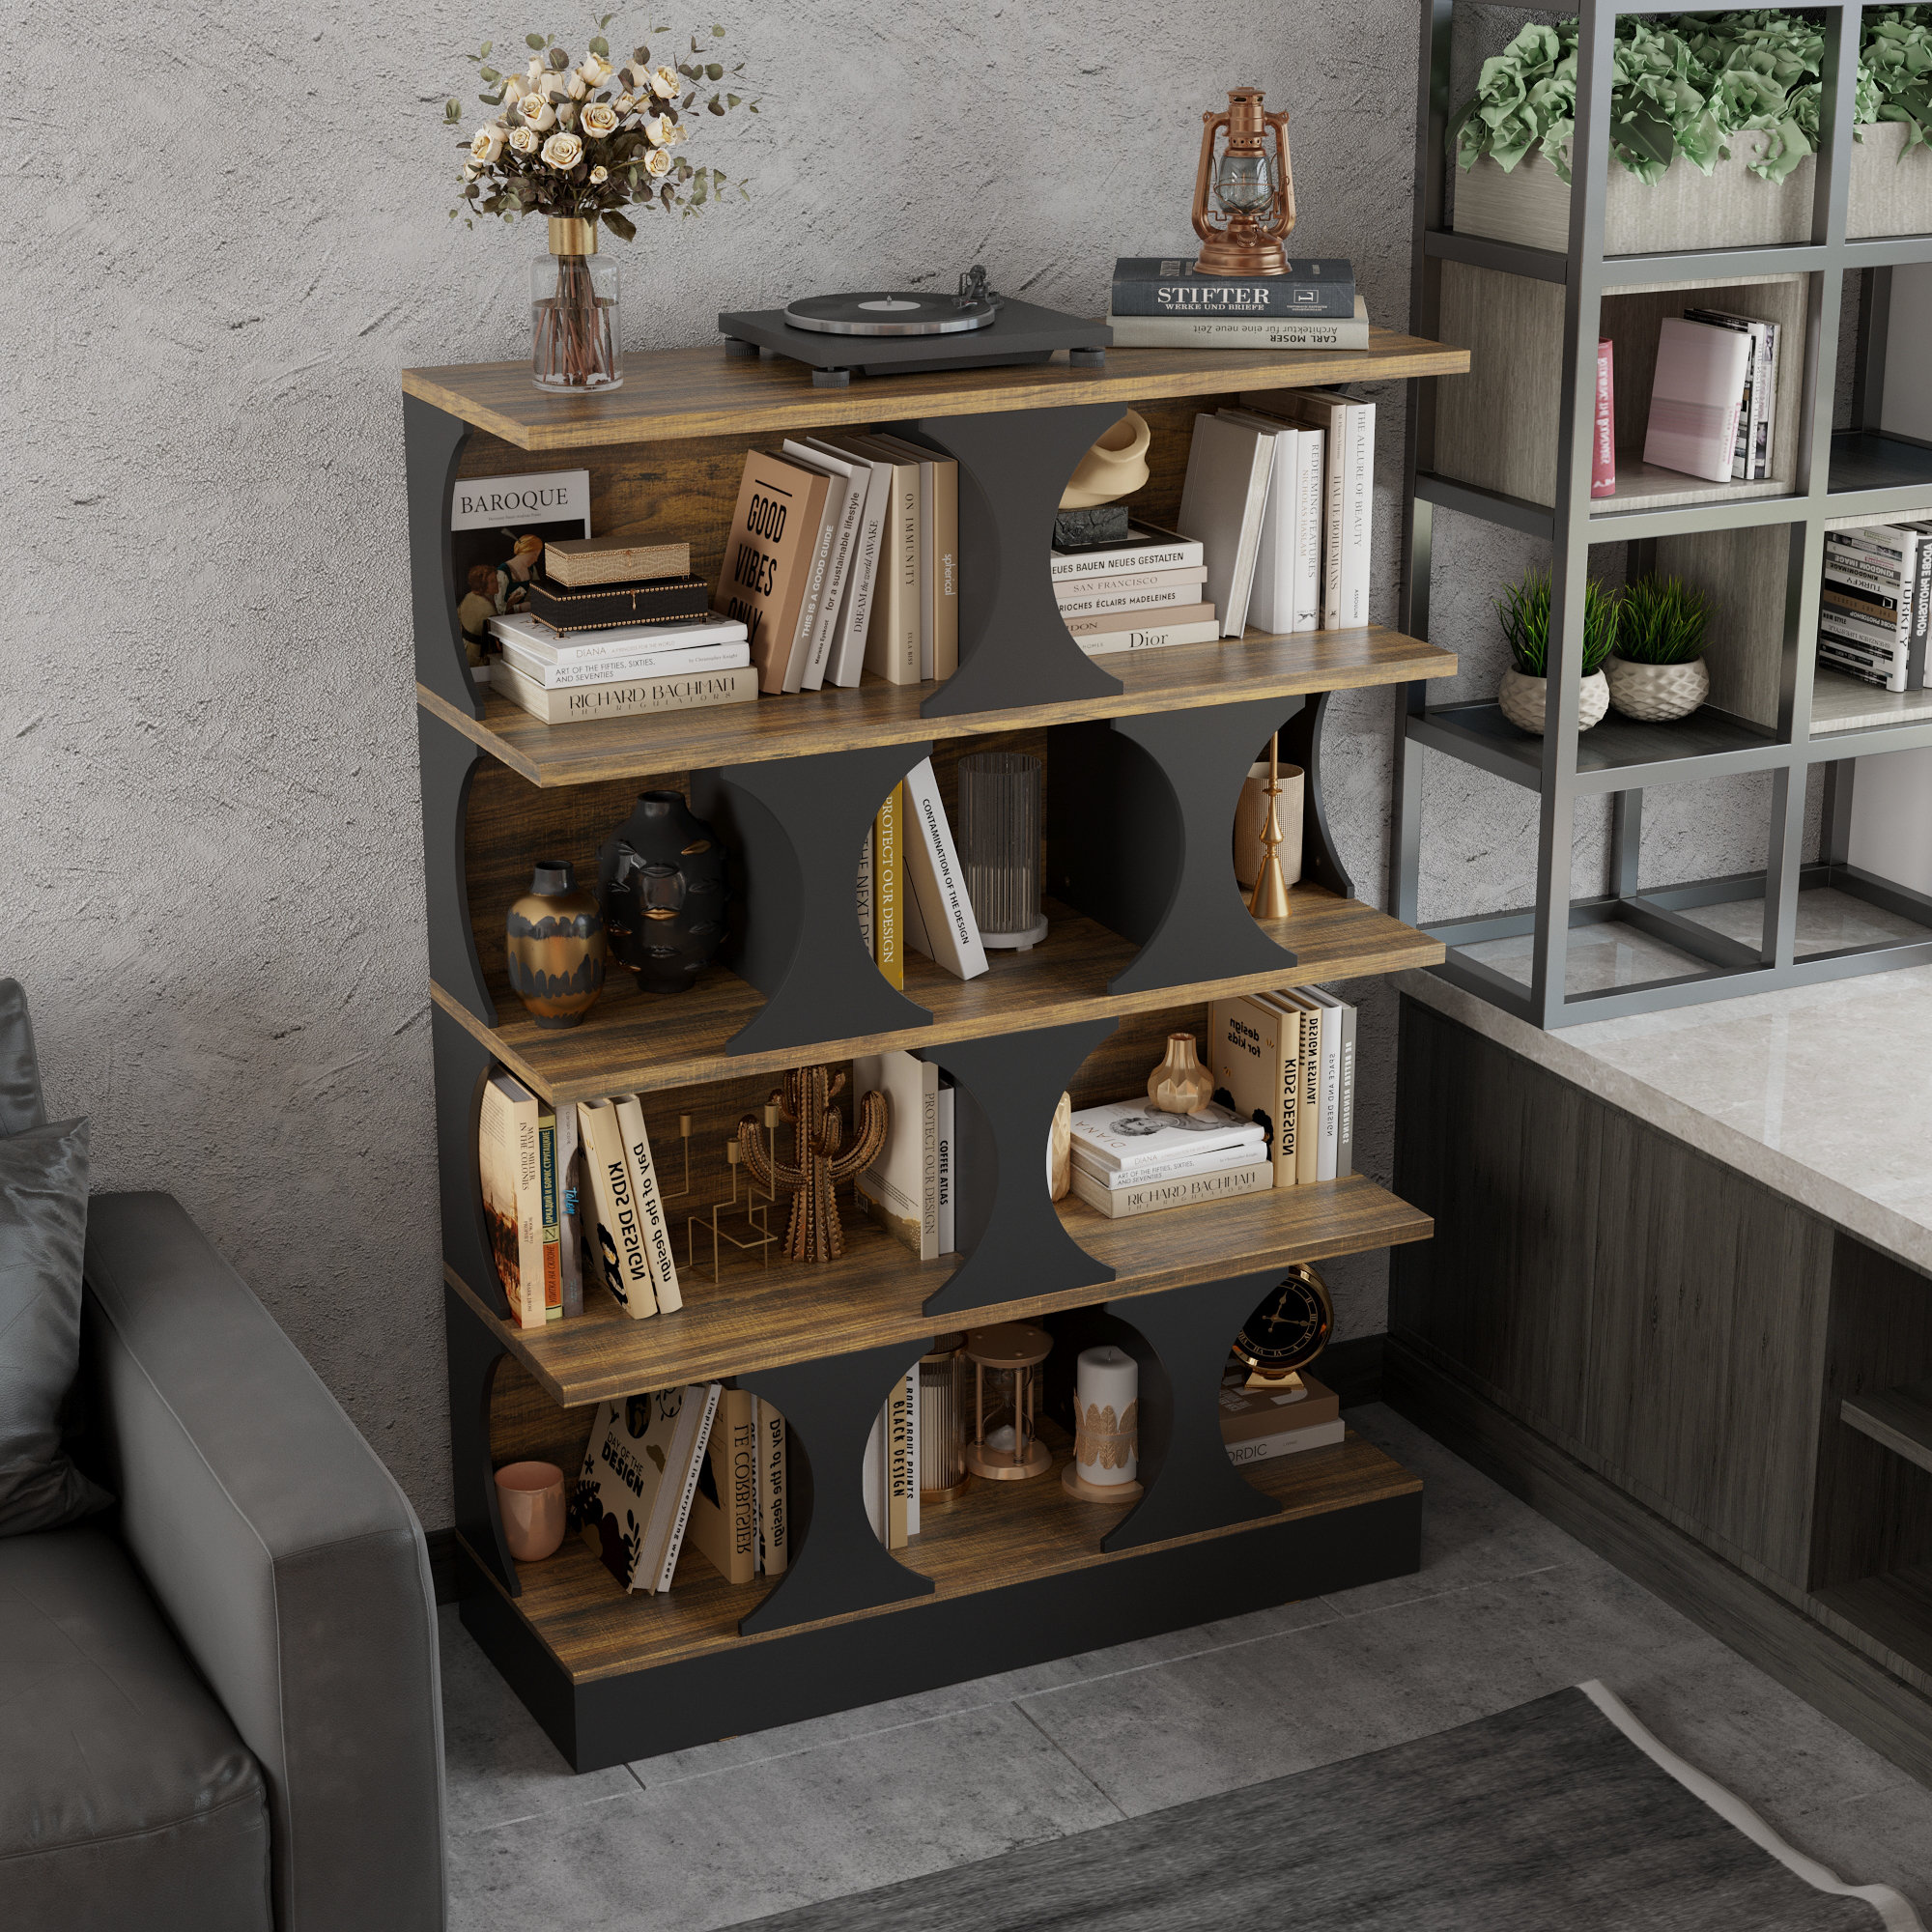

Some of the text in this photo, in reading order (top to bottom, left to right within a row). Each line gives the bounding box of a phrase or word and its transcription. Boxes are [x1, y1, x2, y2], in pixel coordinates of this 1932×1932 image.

[1157, 288, 1270, 304] STIFTER
[1266, 326, 1280, 334] für
[1357, 410, 1366, 433] THE
[1356, 437, 1366, 481] ALLURE
[461, 488, 568, 513] BAROQUE
[1355, 485, 1363, 498] OF
[747, 494, 786, 543] GOOD
[1308, 444, 1319, 579] REDEEMING FEATURES
[825, 598, 835, 611] for
[833, 531, 850, 586] sustainable
[843, 493, 860, 529] lifestyle
[905, 494, 914, 586] ON IMMUNITY
[735, 543, 777, 596] VIBES
[1052, 553, 1183, 575] EUES BAUEN NEUES GESTALTEN
[1330, 521, 1341, 590] BOHEMIANS
[1834, 555, 1858, 565] IMAGE
[1860, 561, 1893, 578] KINGDOM
[802, 526, 834, 638] THIS IS A GOOD GUIDE
[854, 520, 879, 633] DREAM the world AWAKE
[942, 554, 956, 596] spherical
[1073, 577, 1158, 592] SAN FRANCISCO
[1847, 578, 1882, 592] TURKEY
[1059, 592, 1176, 612] RIOCHES ÉCLAIRS MADELEINES
[1899, 582, 1912, 647] TURKEY
[727, 597, 763, 646] ONLY
[576, 646, 607, 658] DIANA
[1129, 631, 1169, 648] Dior
[572, 666, 583, 674] OF
[601, 661, 626, 670] FIFTIES,
[629, 659, 656, 668] SIXTIES,
[576, 670, 614, 681] SEVENTIES
[570, 677, 734, 710] RICHARD BACHMAN
[882, 797, 894, 963] PROTECT OUR DESIGN
[923, 799, 970, 945] CONTAMINATION OF THE DESIGN
[520, 1122, 526, 1130] IN
[1075, 1121, 1126, 1149] DIANA
[542, 1130, 551, 1168] СТРУГАЦКИЕ
[1134, 1154, 1157, 1164] DIANA
[521, 1151, 529, 1191] COLONIES
[544, 1169, 553, 1188] БОРИС
[925, 1094, 935, 1235] PROTECT OUR DESIGN
[1132, 1173, 1162, 1183] SEVENTIES
[1174, 1161, 1194, 1170] SIXTIES,
[1127, 1172, 1255, 1206] RICHARD BACHMAN
[545, 1195, 554, 1224] АРКАДИЙ
[546, 1244, 556, 1269] СКЛОНЕ
[547, 1281, 556, 1303] УЛИТКА
[696, 1397, 716, 1453] simplicity
[608, 1432, 643, 1477] DAY OF THE
[894, 1401, 905, 1497] BLACK DESIGN
[1229, 1443, 1267, 1462] ORDIC
[602, 1440, 644, 1498] DESIGN
[691, 1467, 698, 1478] in
[674, 1483, 694, 1540] everything
[670, 1544, 677, 1558] we
